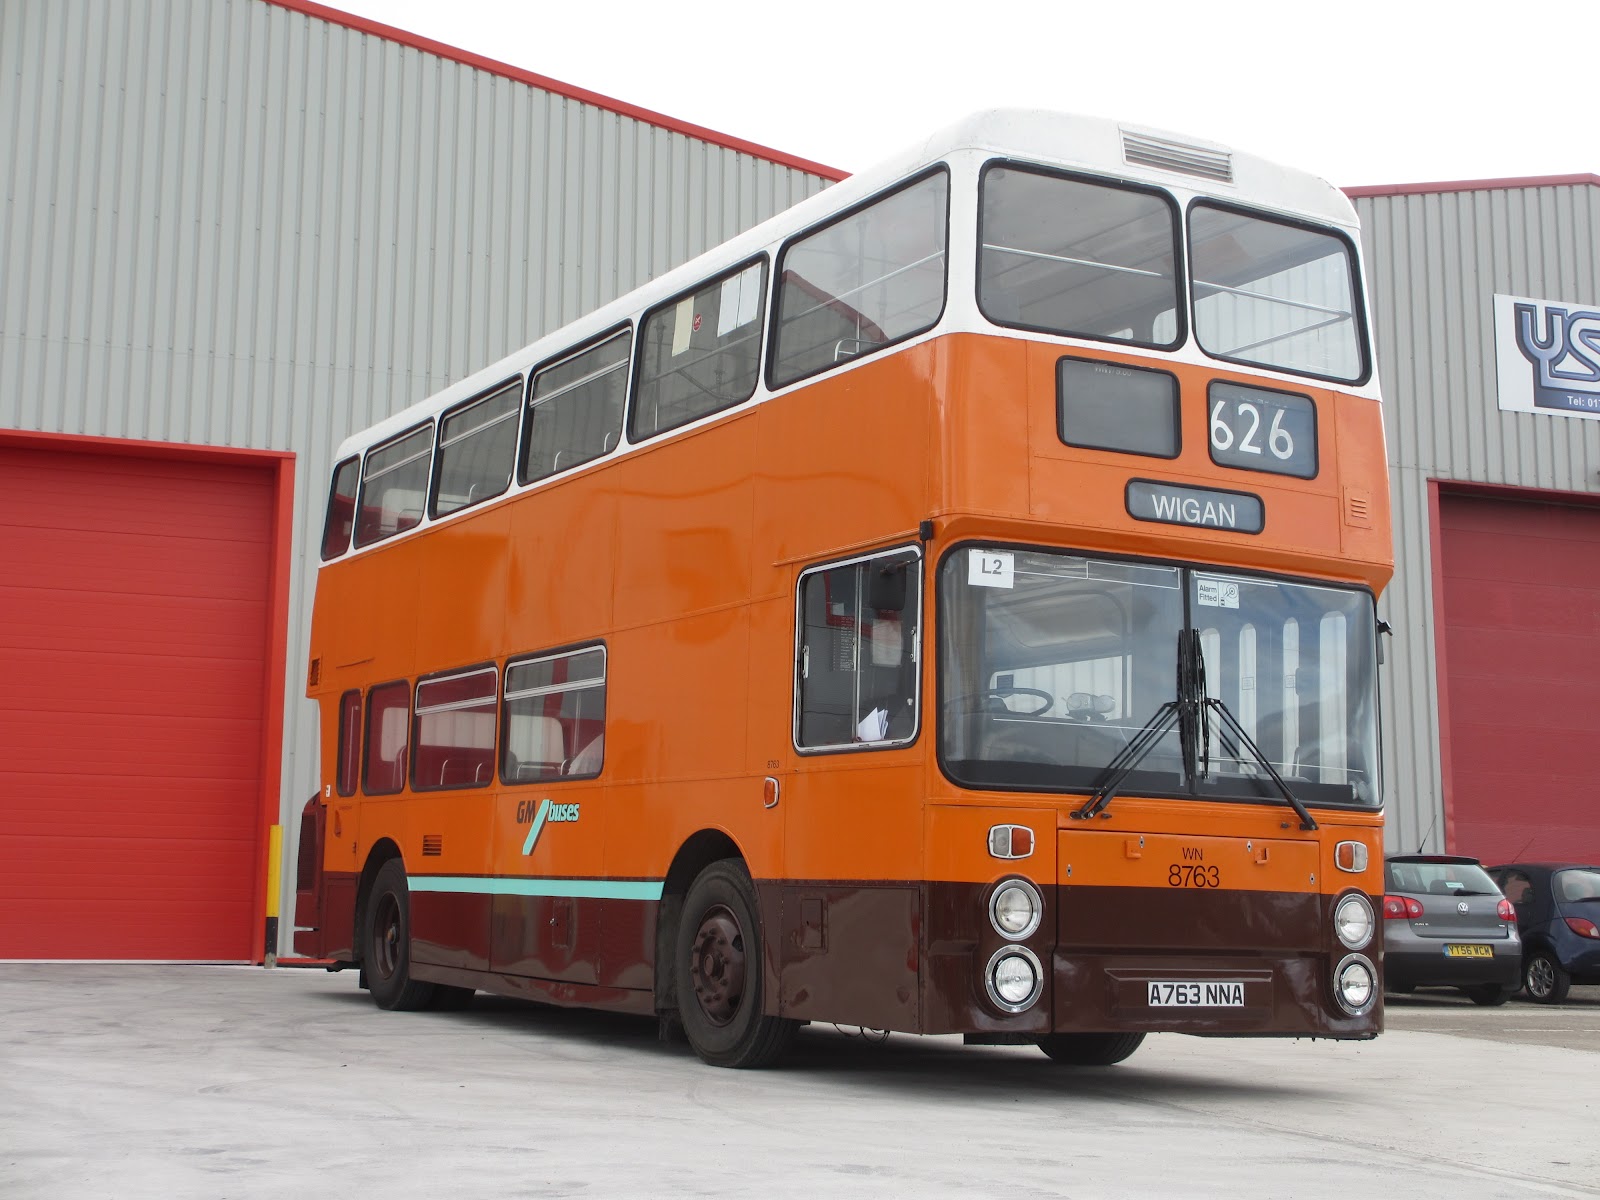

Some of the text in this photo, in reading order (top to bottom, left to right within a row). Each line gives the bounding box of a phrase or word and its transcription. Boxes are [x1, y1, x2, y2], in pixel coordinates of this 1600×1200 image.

[1567, 395, 1585, 407] Tel:
[1211, 400, 1294, 460] 626
[1152, 494, 1235, 528] WIGAN
[981, 558, 1003, 575] L2
[1199, 584, 1218, 593] Alarm
[1199, 593, 1218, 602] Fitted
[516, 799, 580, 824] GM buses
[1182, 847, 1203, 860] WN
[1168, 864, 1220, 888] 8763
[1448, 945, 1473, 955] YT56
[1150, 984, 1243, 1005] A763 NNA
